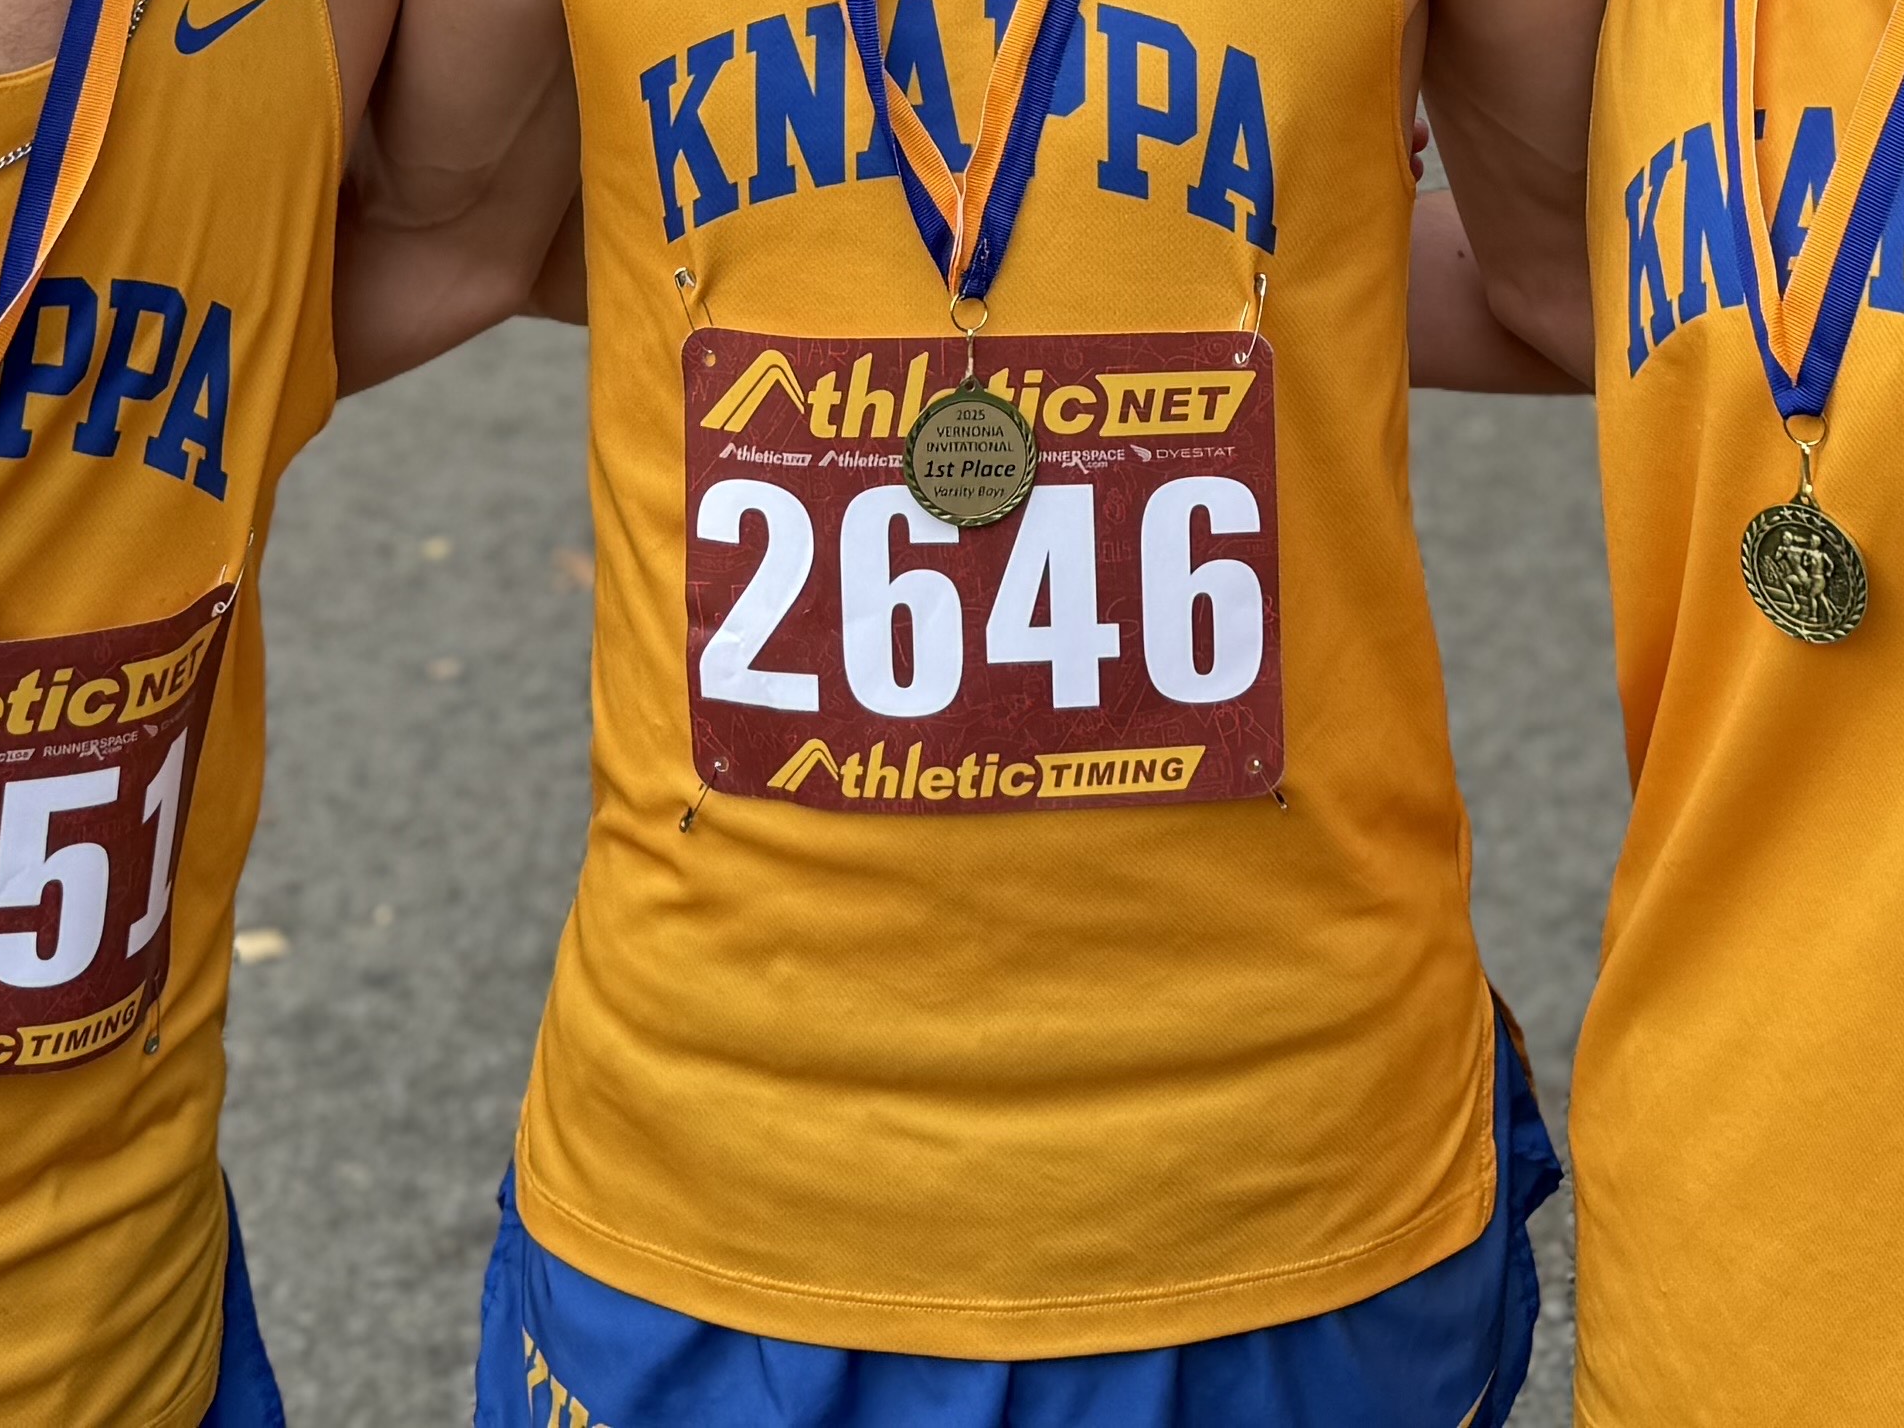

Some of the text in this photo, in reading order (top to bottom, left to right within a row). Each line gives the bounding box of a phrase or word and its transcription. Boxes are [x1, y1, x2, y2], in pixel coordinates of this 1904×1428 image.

[956, 408, 986, 421] 2025
[936, 425, 1005, 438] VERNONIA
[926, 441, 1015, 453] INVITATIONAL
[1156, 446, 1236, 459] DYESTAT
[924, 459, 1016, 478] 1st Place
[933, 485, 975, 499] Varsity
[694, 474, 1263, 719] 2646
[42, 730, 139, 758] RUNNERSPACE
